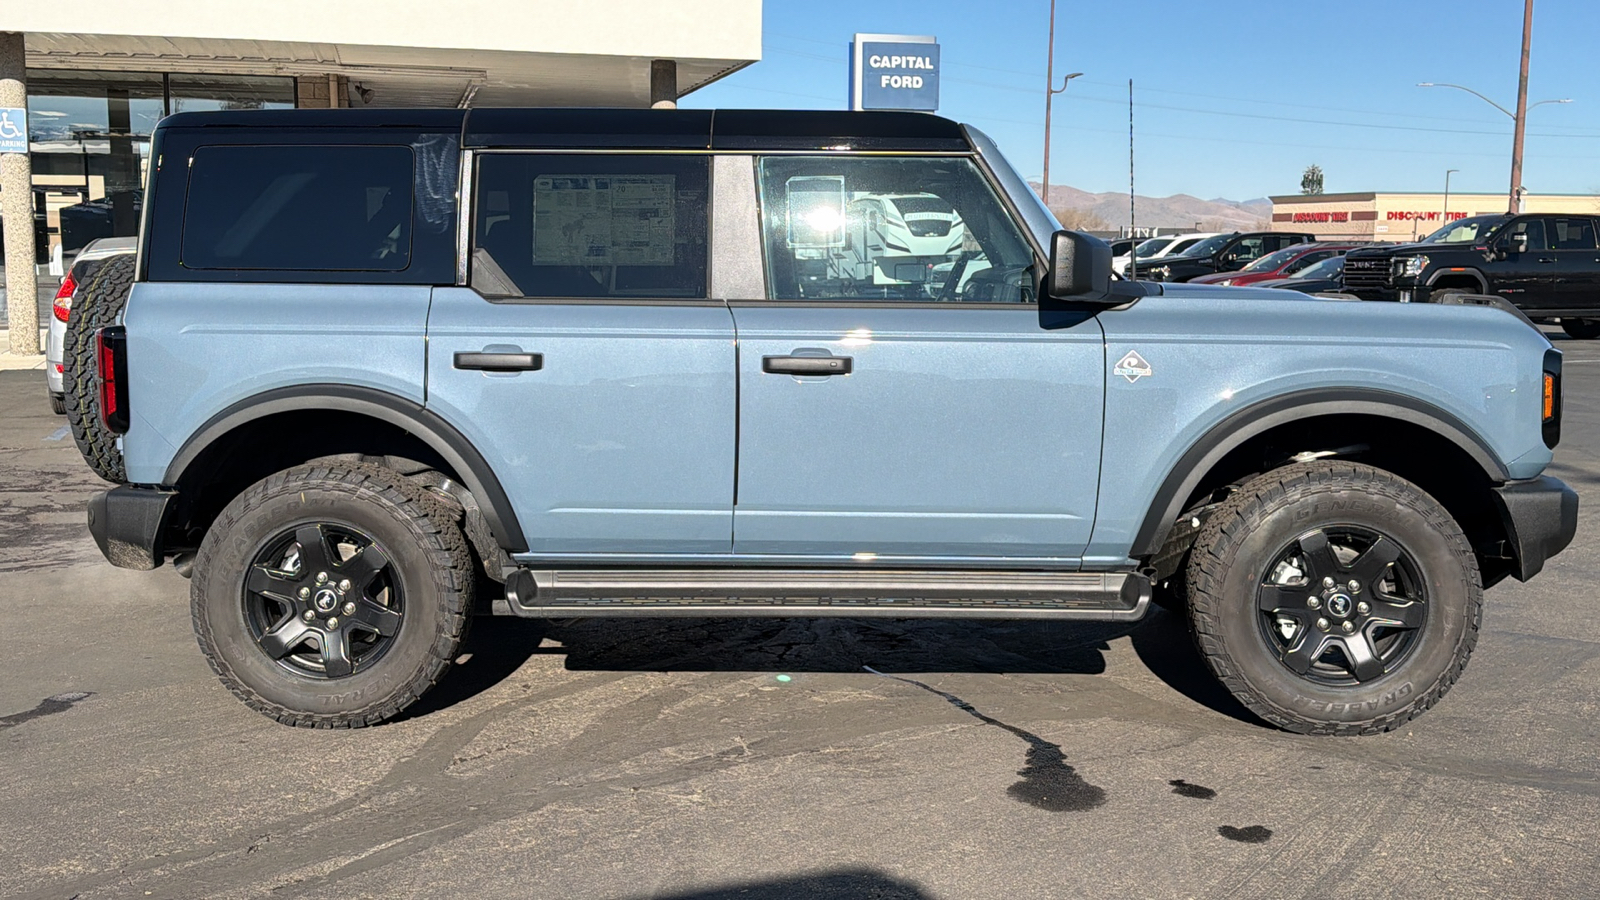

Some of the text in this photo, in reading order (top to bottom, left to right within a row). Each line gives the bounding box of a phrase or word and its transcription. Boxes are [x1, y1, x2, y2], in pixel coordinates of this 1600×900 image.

[869, 55, 934, 69] CAPITAL
[881, 75, 923, 88] FORD
[0, 140, 25, 148] ARKING
[1386, 211, 1468, 221] DISCOUNT TIRE
